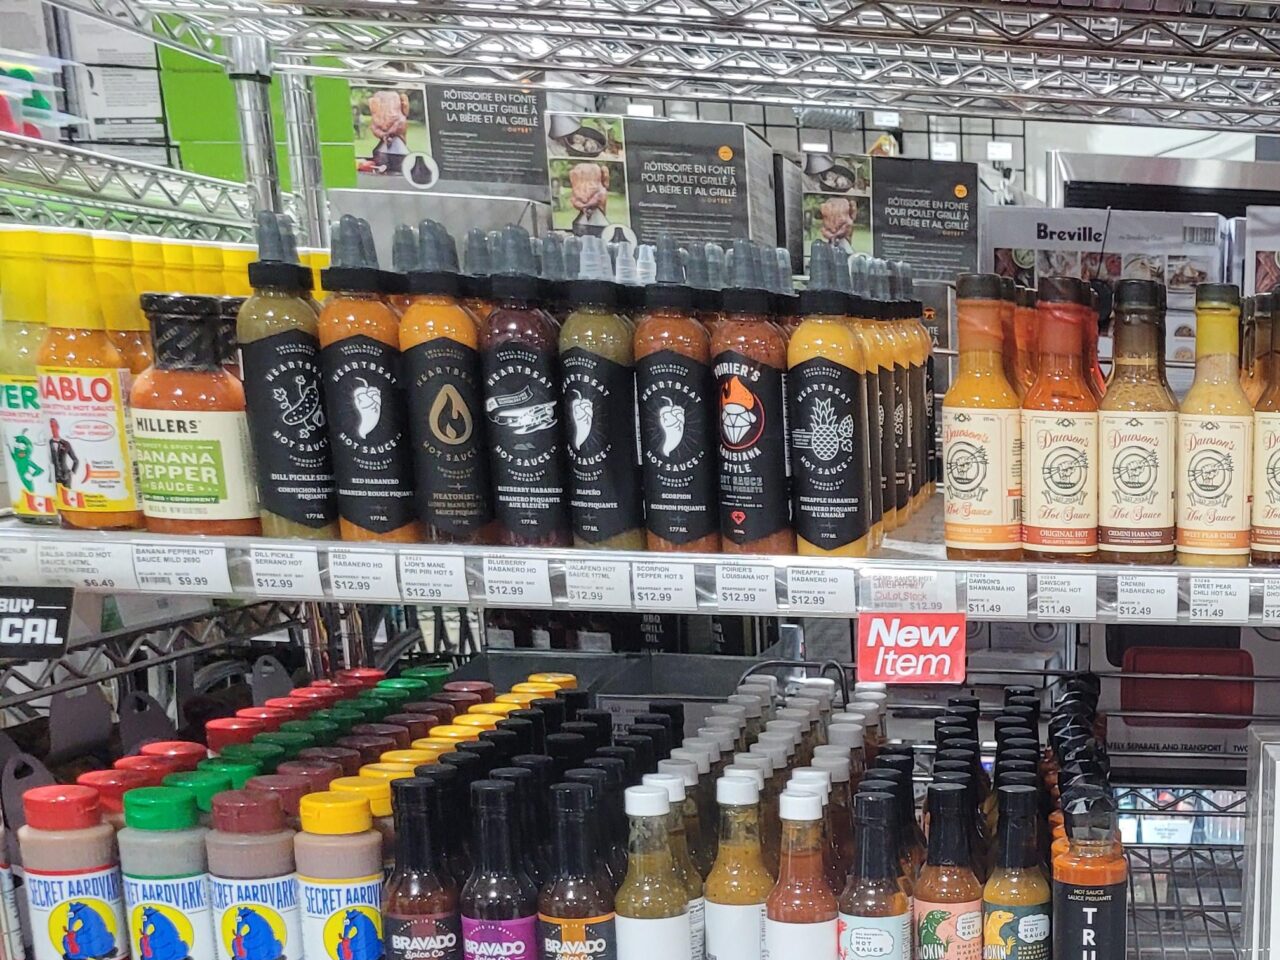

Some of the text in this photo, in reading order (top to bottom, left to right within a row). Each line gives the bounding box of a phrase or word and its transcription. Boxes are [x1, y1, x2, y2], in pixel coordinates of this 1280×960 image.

[494, 93, 506, 102] EN
[508, 94, 537, 104] FONTE
[441, 102, 464, 111] POUR
[467, 103, 498, 113] POULET
[447, 113, 457, 122] LA
[484, 116, 493, 124] ET
[708, 166, 736, 175] FONTE
[642, 174, 698, 185] POUR POULET
[1036, 223, 1102, 244] Breville
[138, 451, 214, 464] BANANA
[138, 465, 218, 484] PEPPER
[151, 481, 194, 492] SAUCE
[1040, 530, 1072, 538] ORIGINAL
[85, 579, 114, 588] $6.49
[179, 577, 208, 586] $9.99
[257, 578, 292, 588] $12.99
[334, 581, 369, 590] $12.99
[489, 586, 523, 595] $12.99
[722, 592, 756, 601] $12.99
[792, 596, 825, 605] $12.99
[0, 598, 35, 613] BUY
[969, 604, 1001, 612] $11.49
[1039, 605, 1071, 614] $11.49
[1119, 606, 1151, 615] $12.49
[1192, 609, 1224, 617] $11.49
[868, 618, 959, 648] New
[875, 651, 951, 676] Item
[29, 878, 64, 901] SECRET
[306, 886, 338, 916] SECRET
[392, 932, 456, 949] BRAVADO
[545, 938, 606, 953] BRAVADO
[465, 939, 526, 957] BRAVADO
